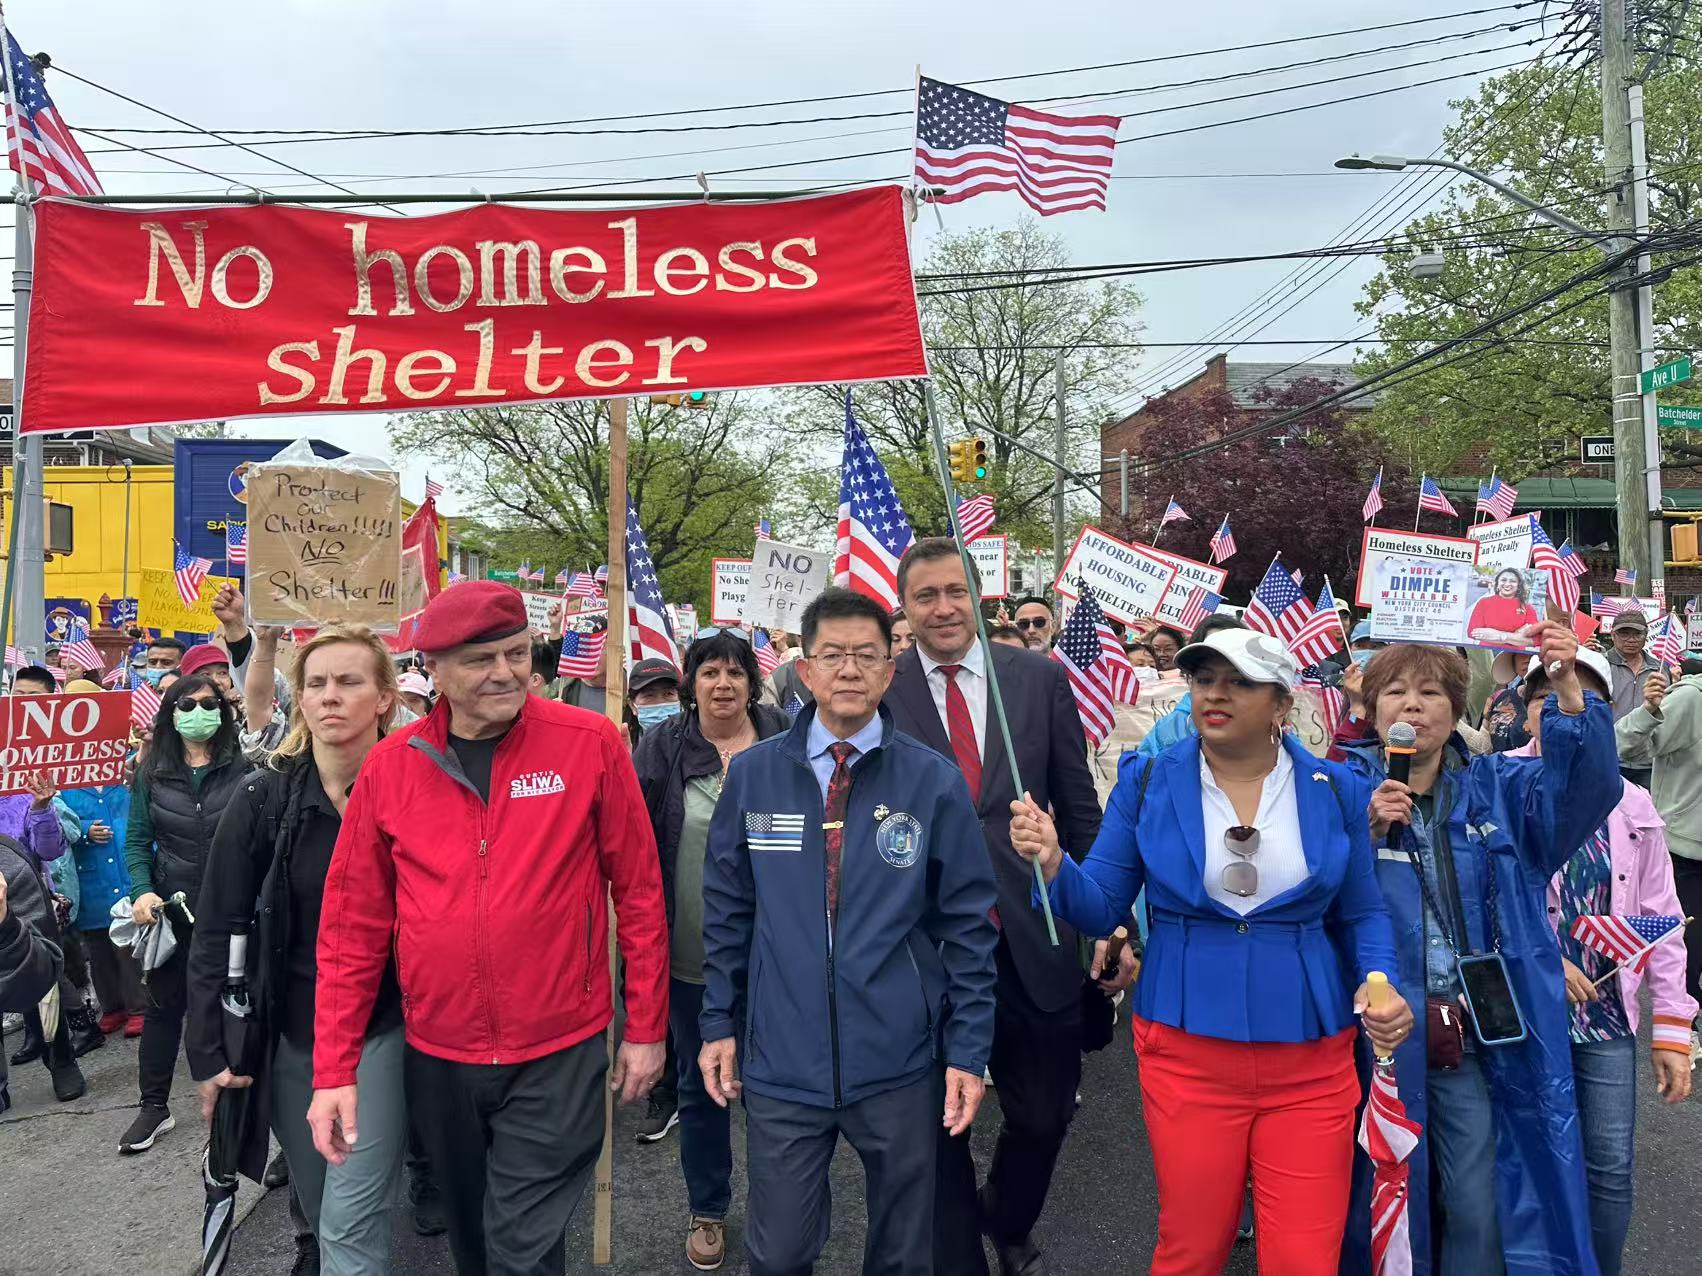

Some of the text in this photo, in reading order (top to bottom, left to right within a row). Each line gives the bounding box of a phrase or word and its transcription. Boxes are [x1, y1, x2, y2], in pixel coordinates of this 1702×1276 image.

[134, 216, 818, 316] No homeless
[258, 318, 707, 405] shelter
[1652, 364, 1677, 388] Ave U
[1658, 407, 1700, 420] Batchelder
[1594, 444, 1614, 455] ONE
[274, 473, 365, 504] Protect
[296, 502, 336, 516] our
[301, 538, 345, 560] NO
[1081, 534, 1168, 582] AFFORDABLE
[1368, 536, 1423, 554] Homeless
[1425, 543, 1473, 560] Shelters
[1479, 540, 1519, 555] an't Really
[768, 549, 813, 574] NO
[1410, 567, 1433, 576] VOTE
[720, 575, 731, 585] No
[760, 573, 812, 595] Shel-
[1087, 558, 1147, 595] HOUSING
[1390, 576, 1451, 593] DIMPLE
[767, 593, 799, 612] ter
[1062, 572, 1079, 587] NO
[1090, 585, 1151, 620] SHELTERS
[15, 697, 101, 740] NO
[0, 738, 127, 768] OMELESS
[510, 774, 564, 791] SLIWA
[519, 770, 554, 780] CURTIS
[880, 820, 892, 833] NEW
[892, 814, 909, 822] YORK
[890, 856, 911, 865] SENATE
